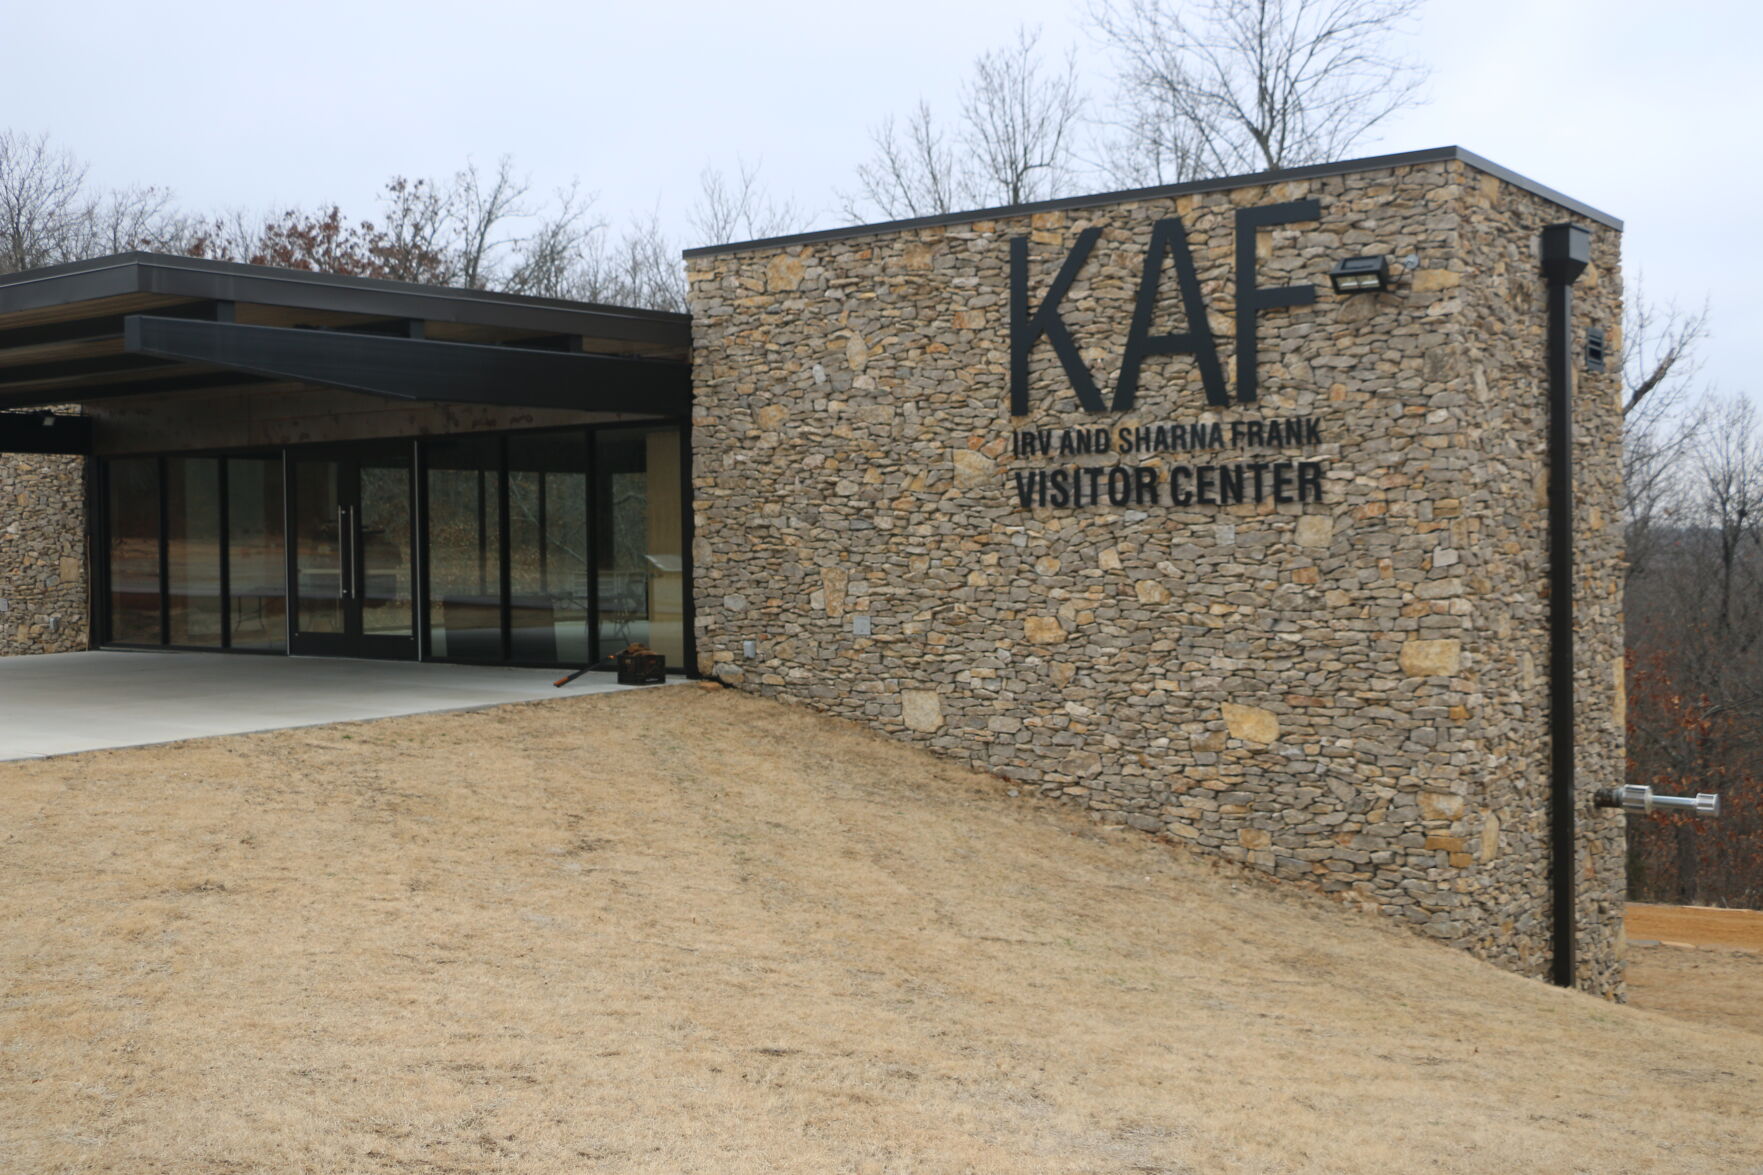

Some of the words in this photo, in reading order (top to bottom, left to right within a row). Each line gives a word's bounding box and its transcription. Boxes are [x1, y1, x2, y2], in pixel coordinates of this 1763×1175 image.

[1010, 199, 1320, 416] KAF
[1013, 428, 1051, 456] IRV
[1060, 427, 1110, 454] AND
[1119, 422, 1224, 453] SHARNA
[1232, 417, 1322, 448] FRANK
[1015, 466, 1158, 508] VISITOR
[1171, 461, 1323, 505] CENTER
